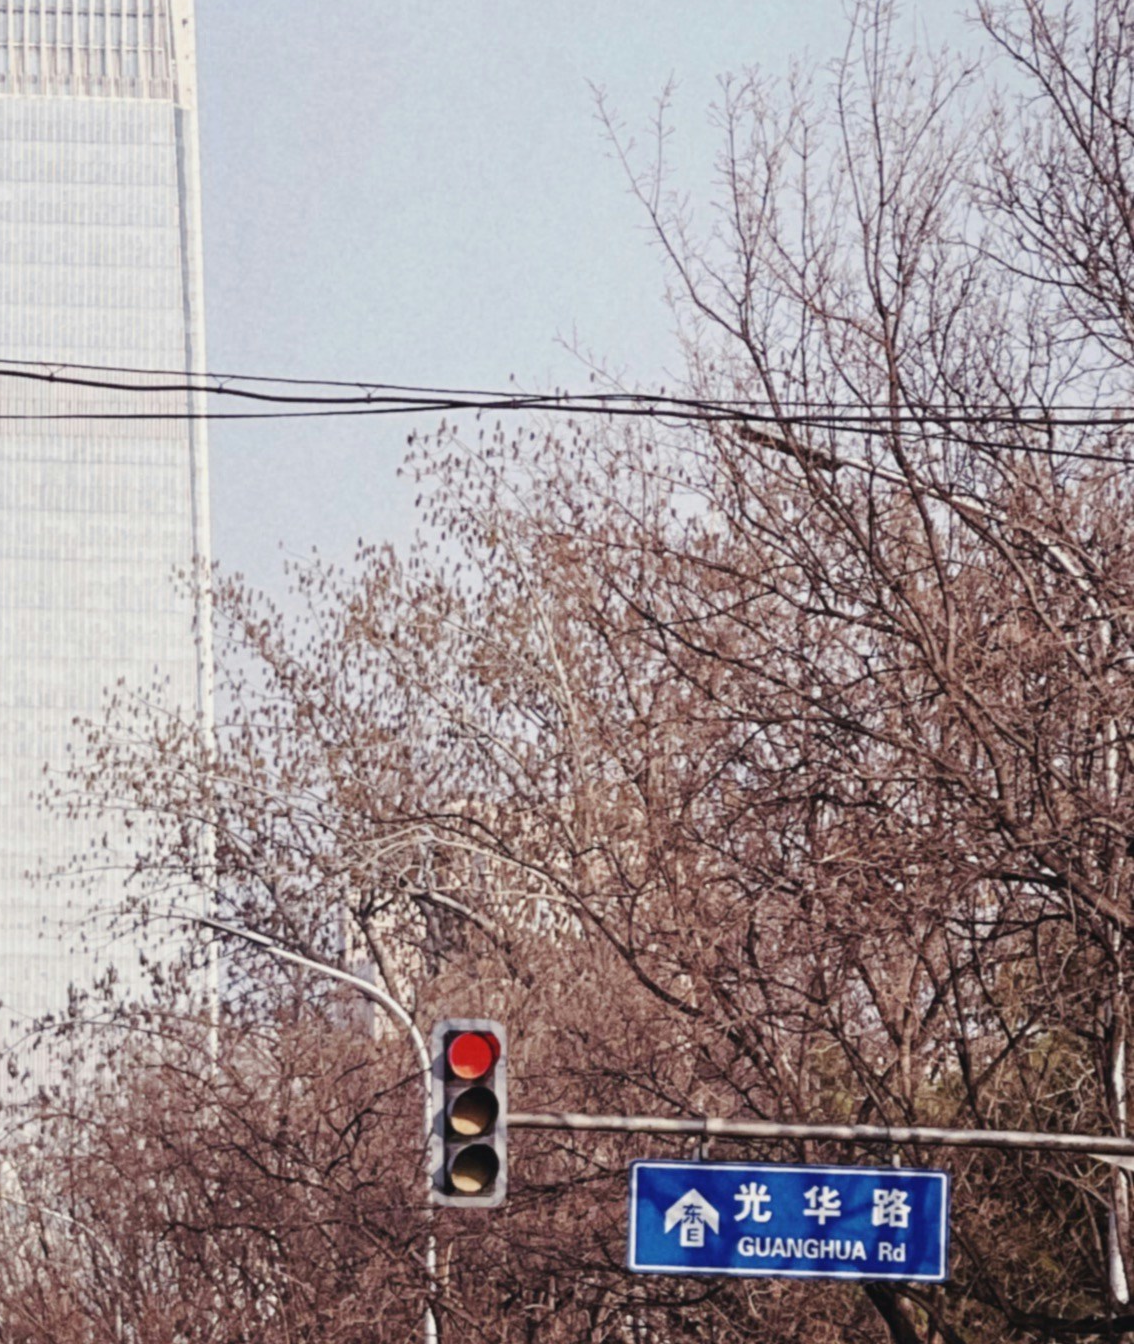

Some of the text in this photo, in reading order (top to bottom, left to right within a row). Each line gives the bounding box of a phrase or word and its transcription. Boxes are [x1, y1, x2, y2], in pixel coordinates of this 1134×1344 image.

[682, 1203, 704, 1225] 东
[734, 1182, 912, 1229] 光华路
[686, 1228, 700, 1242] E
[737, 1236, 906, 1262] GUANGHUA Rd
